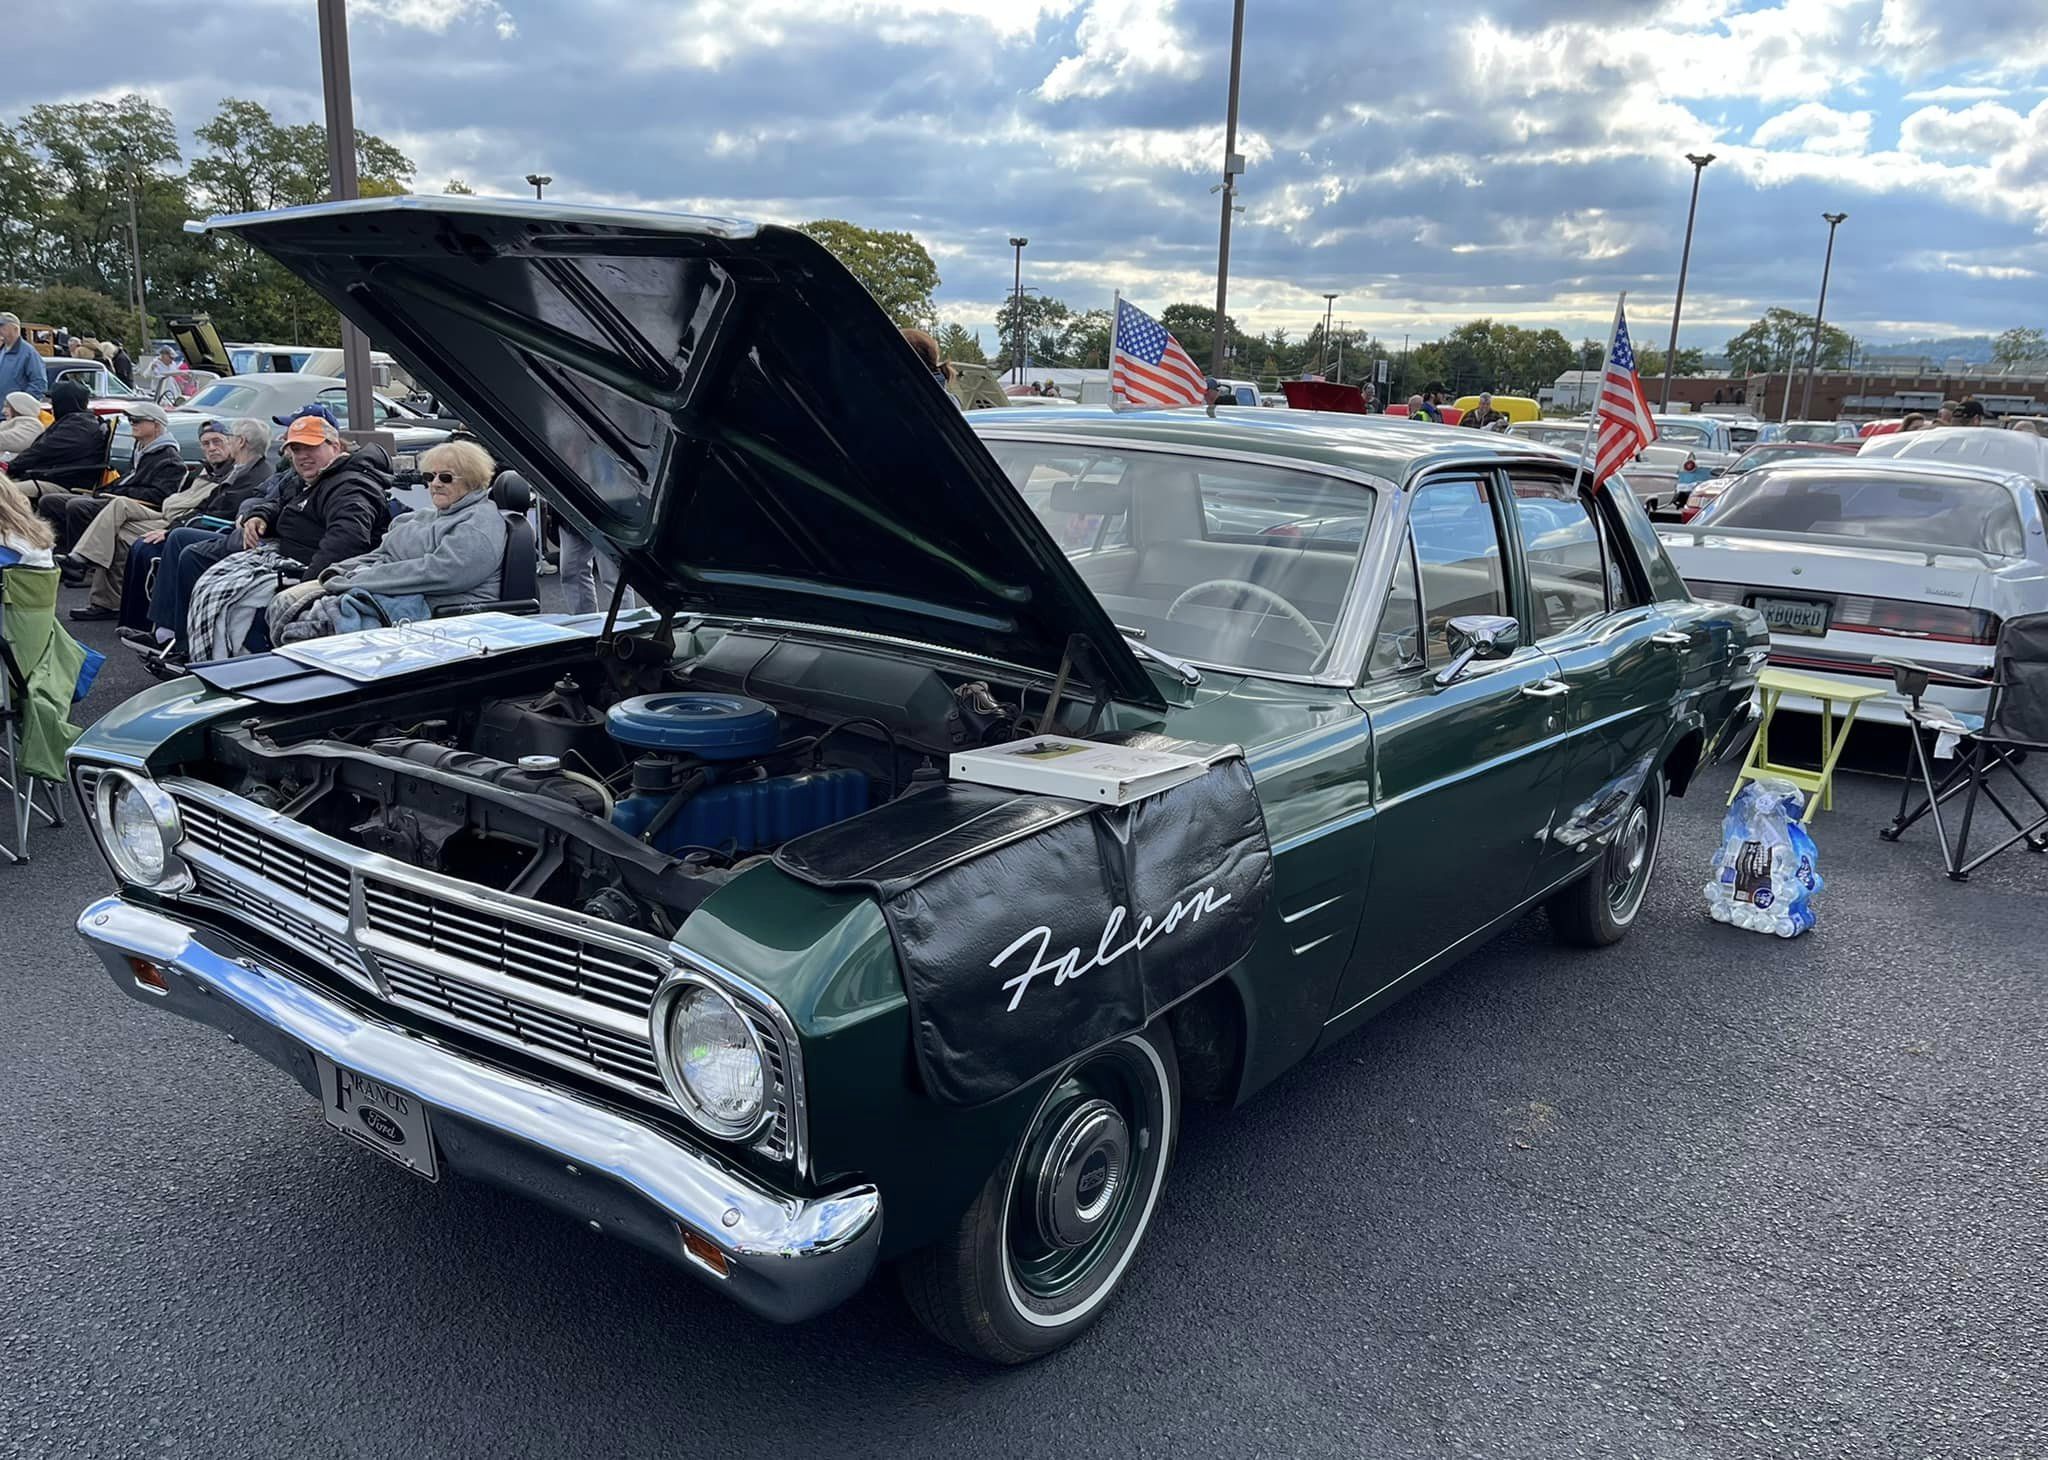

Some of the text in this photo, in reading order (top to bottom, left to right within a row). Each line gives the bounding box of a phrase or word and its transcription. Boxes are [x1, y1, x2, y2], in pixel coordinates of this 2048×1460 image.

[989, 886, 1232, 1013] Falcon
[335, 1067, 409, 1115] FRANCIS
[367, 1110, 397, 1139] Ford
